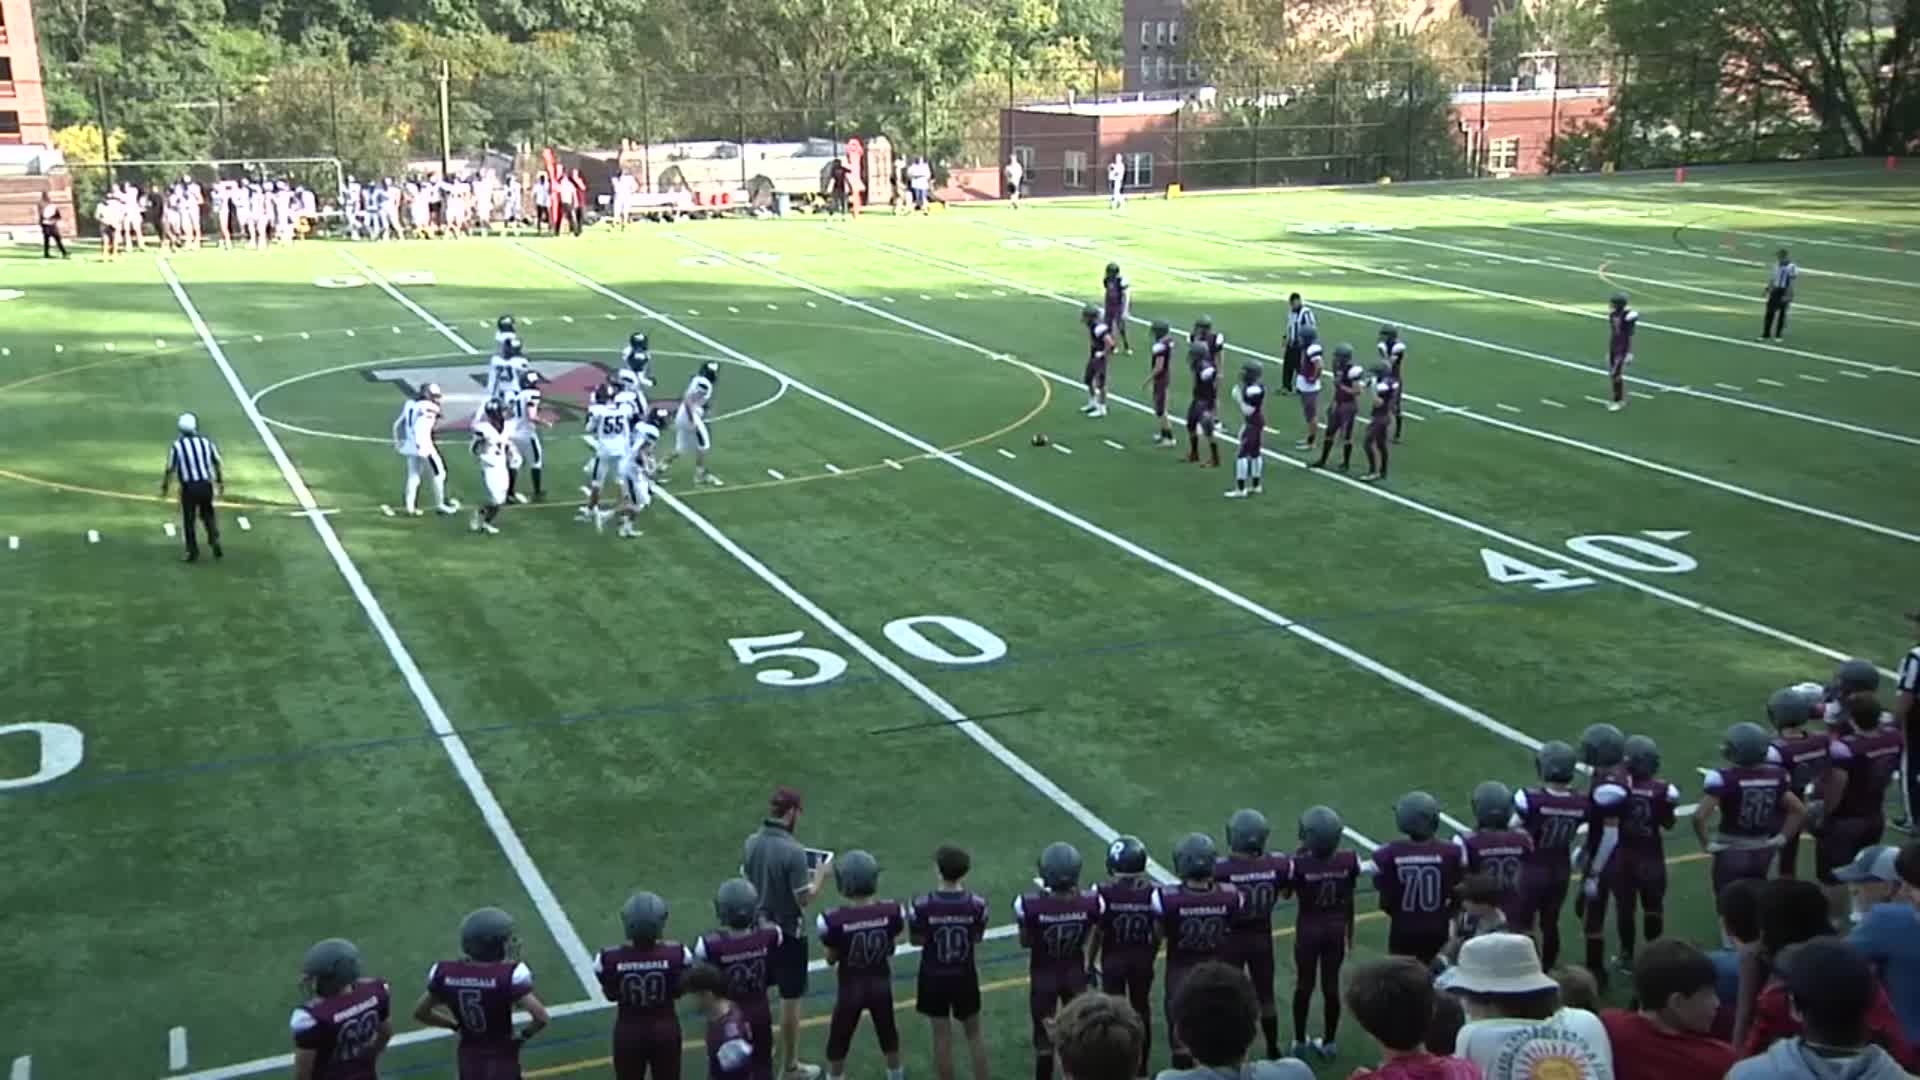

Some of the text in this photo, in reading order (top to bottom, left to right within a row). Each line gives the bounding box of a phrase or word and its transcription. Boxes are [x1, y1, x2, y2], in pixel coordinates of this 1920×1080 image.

[603, 415, 625, 435] 55
[1480, 534, 1698, 589] 40
[728, 616, 1007, 686] 50
[1110, 841, 1126, 862] R
[1397, 865, 1440, 912] 70
